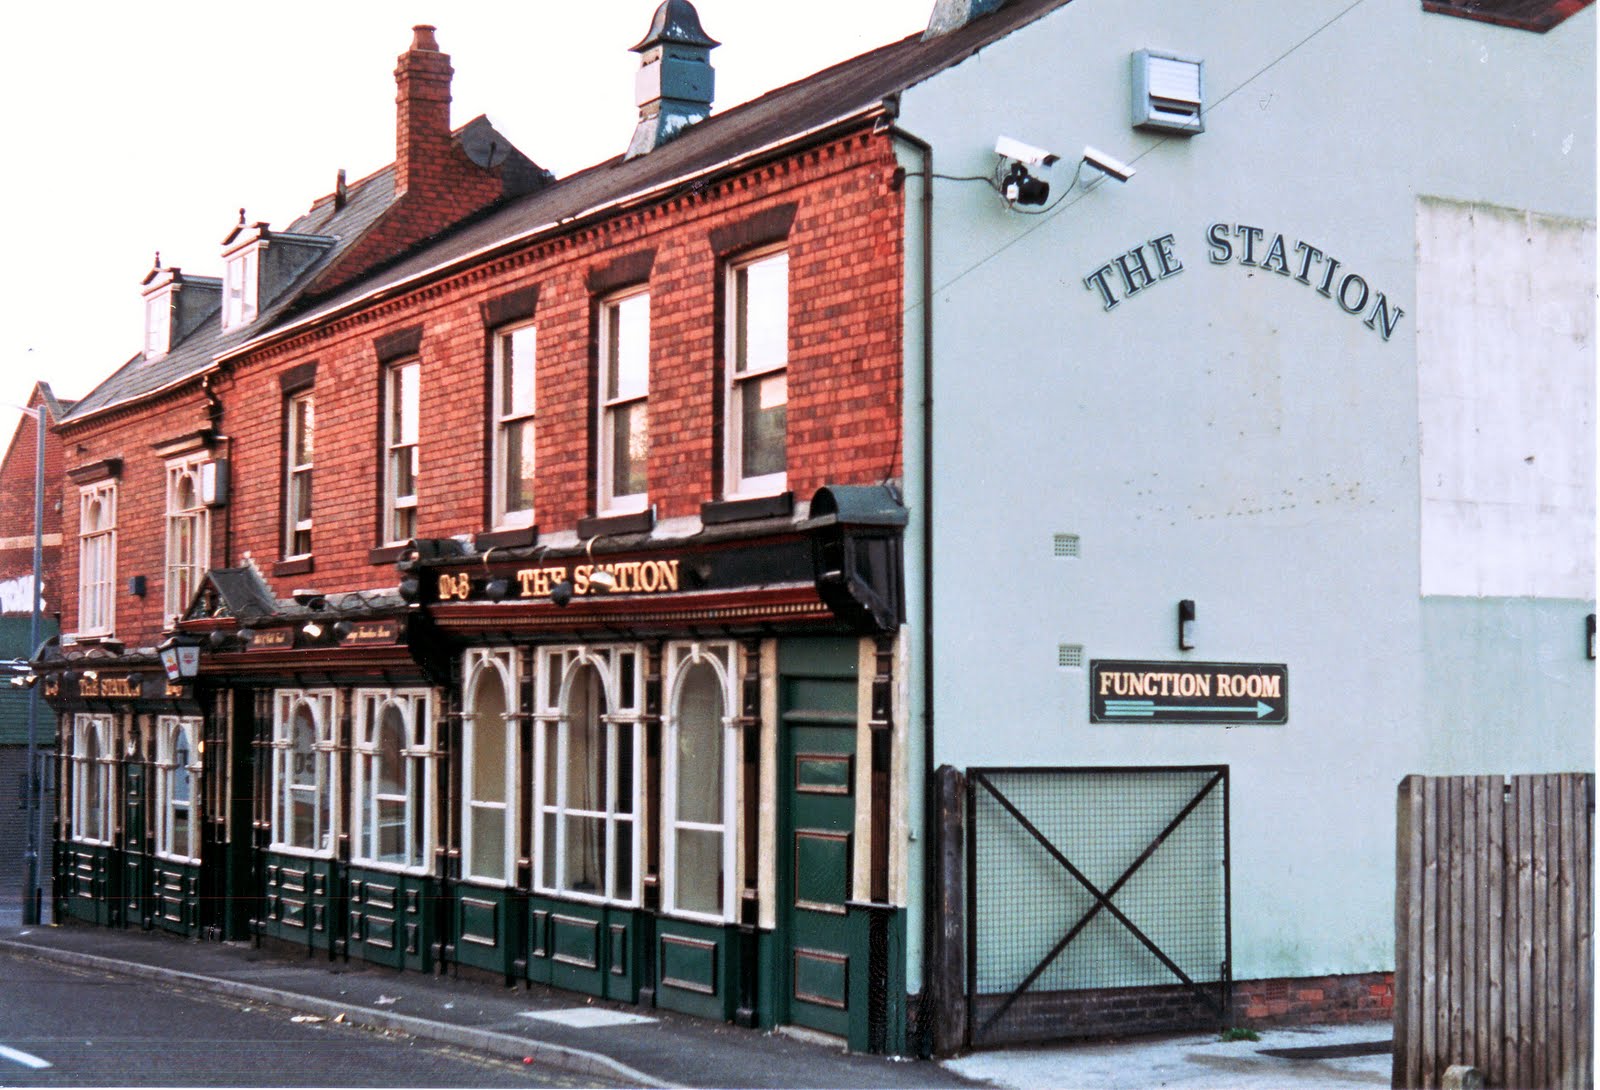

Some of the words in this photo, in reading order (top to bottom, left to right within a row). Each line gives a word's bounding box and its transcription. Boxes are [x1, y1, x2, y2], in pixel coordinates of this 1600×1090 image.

[1083, 233, 1184, 312] THE
[1206, 222, 1405, 342] STATION
[573, 560, 680, 595] SATION
[1099, 671, 1212, 697] FUNCTION
[1216, 674, 1282, 698] ROOM
